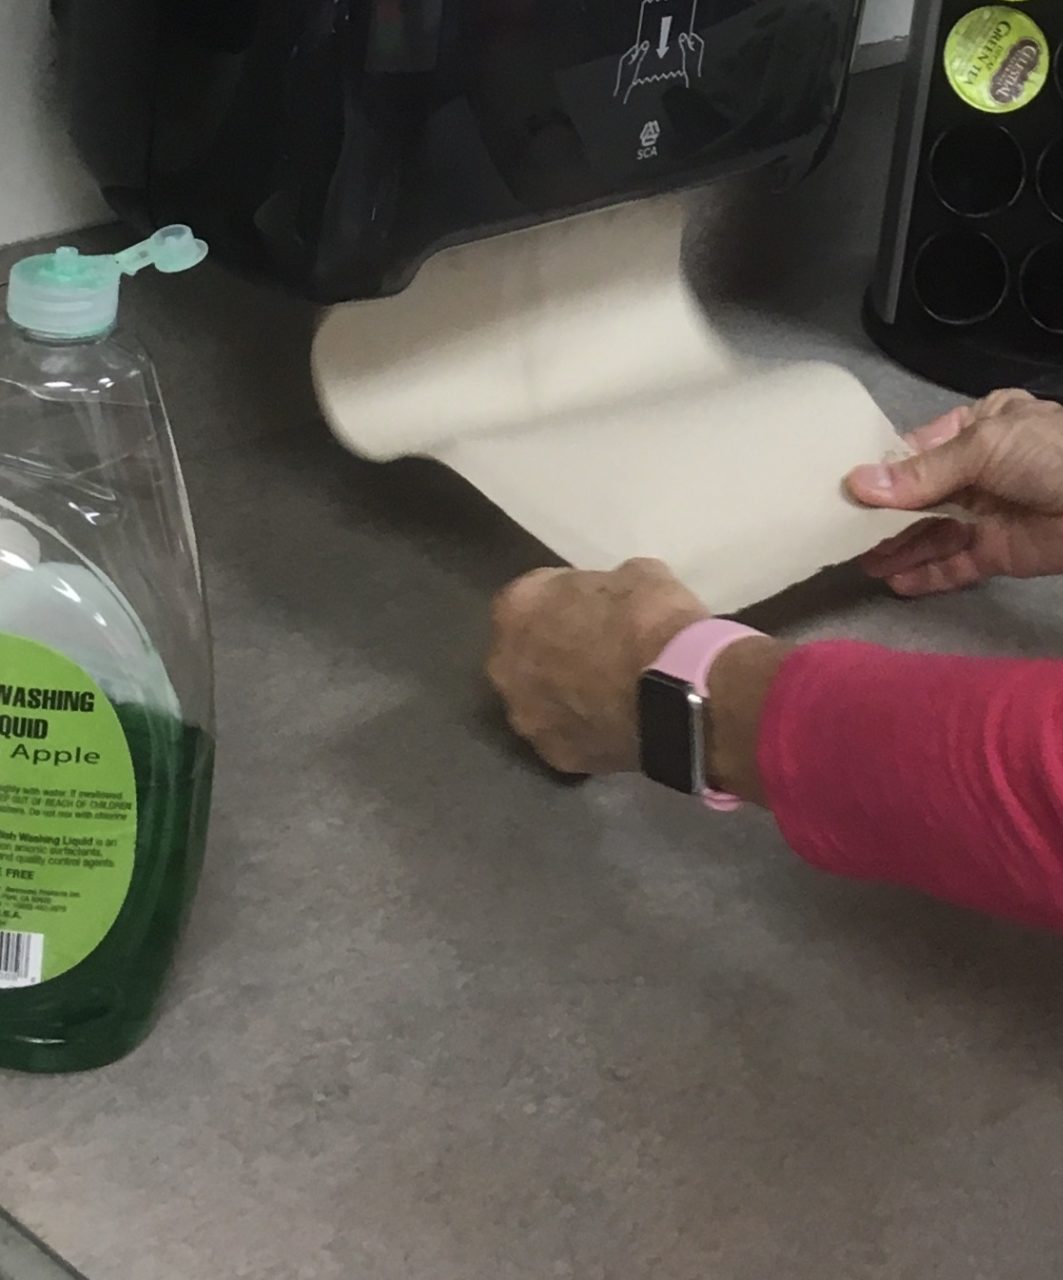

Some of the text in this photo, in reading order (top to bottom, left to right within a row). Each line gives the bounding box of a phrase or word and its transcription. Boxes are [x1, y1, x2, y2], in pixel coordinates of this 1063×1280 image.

[977, 21, 1012, 62] GREEN
[963, 64, 983, 85] TEA
[996, 45, 1036, 97] CELESTIAL
[636, 146, 659, 160] SCA
[10, 743, 101, 767] Apple
[19, 832, 60, 846] Washing
[63, 835, 94, 847] Liquid
[6, 868, 35, 880] FREE
